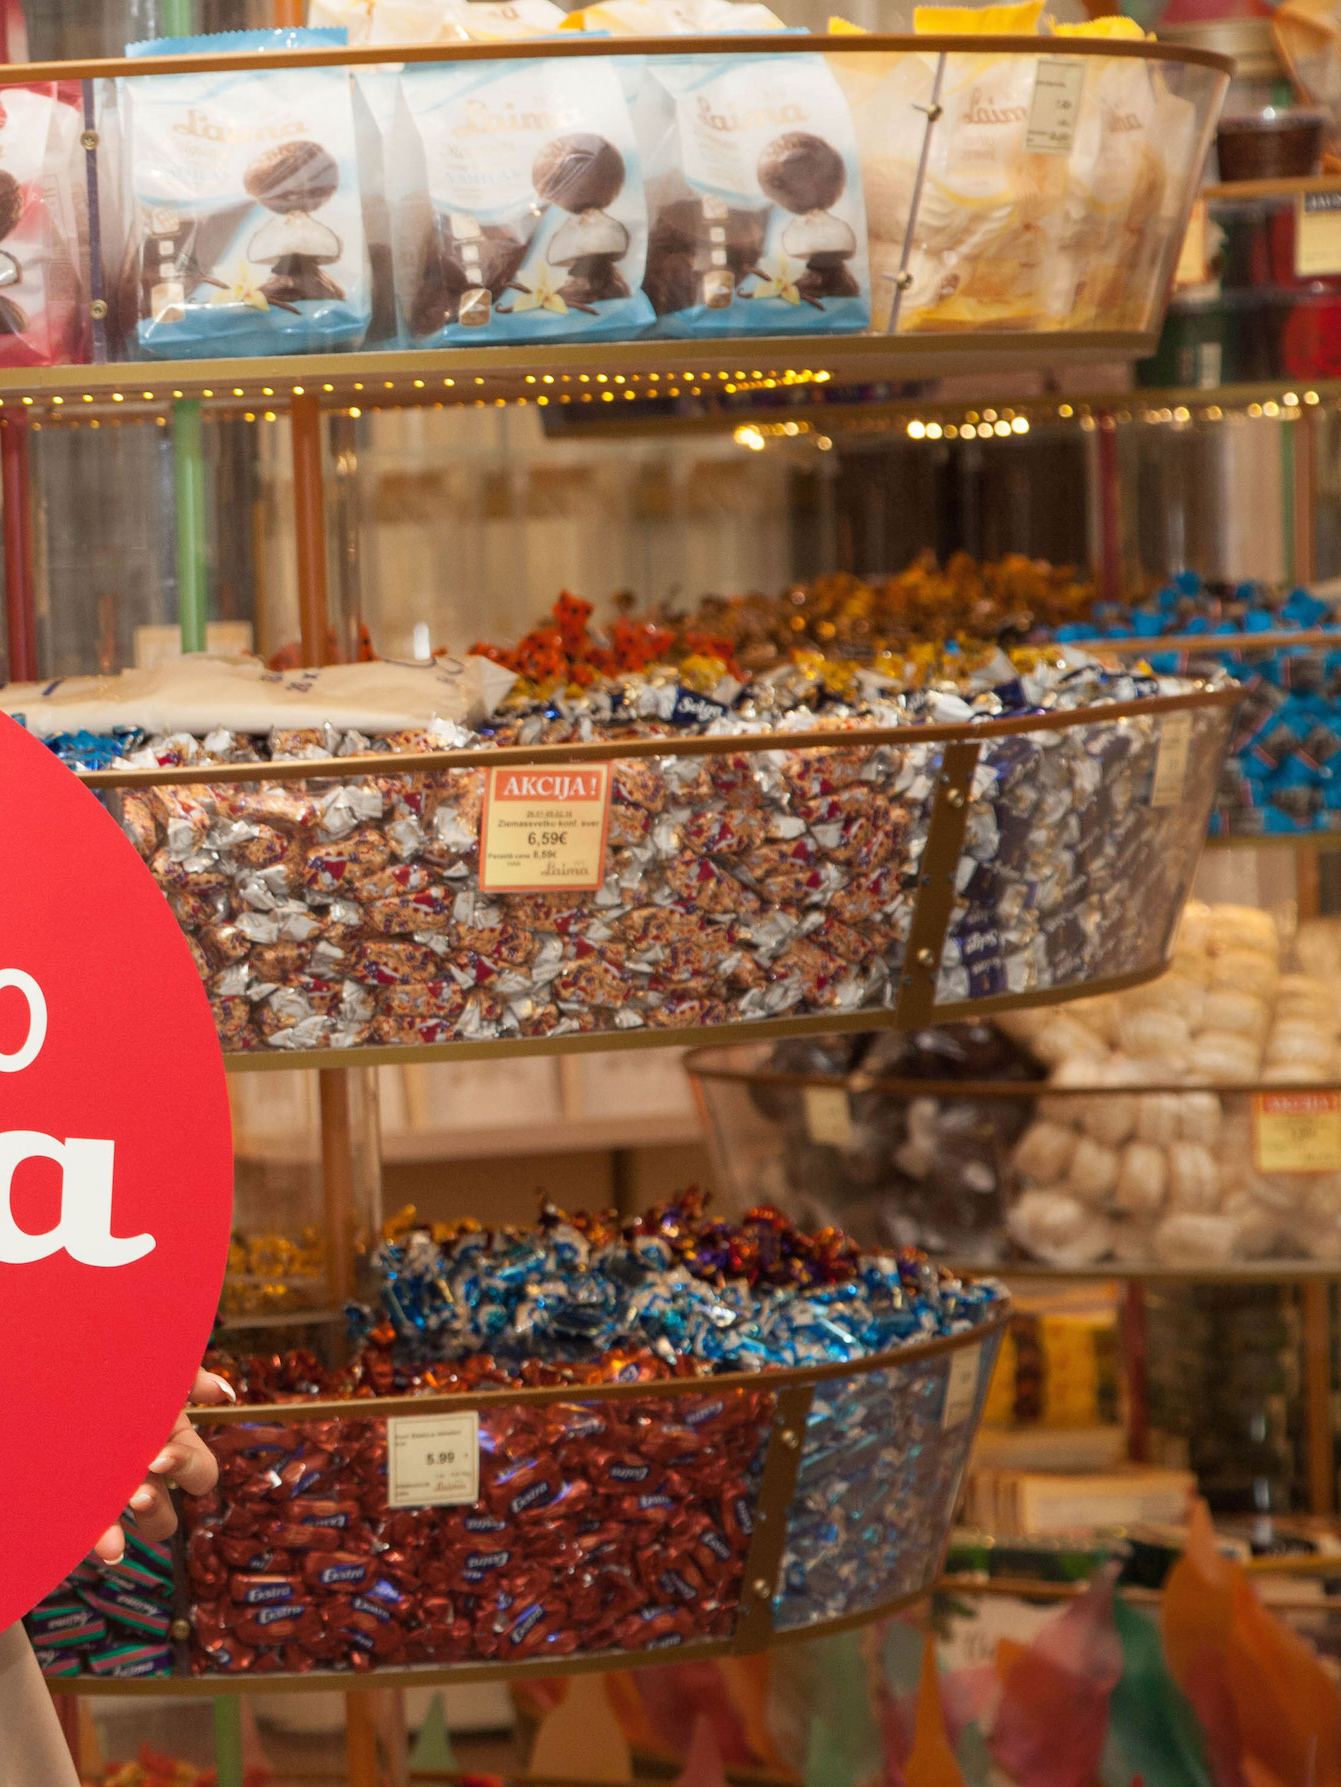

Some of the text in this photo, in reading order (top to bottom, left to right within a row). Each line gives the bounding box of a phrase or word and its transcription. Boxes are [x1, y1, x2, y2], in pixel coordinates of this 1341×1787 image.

[503, 776, 586, 799] AKCIJA
[527, 832, 568, 847] 6,59€
[426, 1451, 456, 1466] 5.99
[322, 1565, 366, 1583] Ekstra
[247, 1580, 292, 1603] Ekstra
